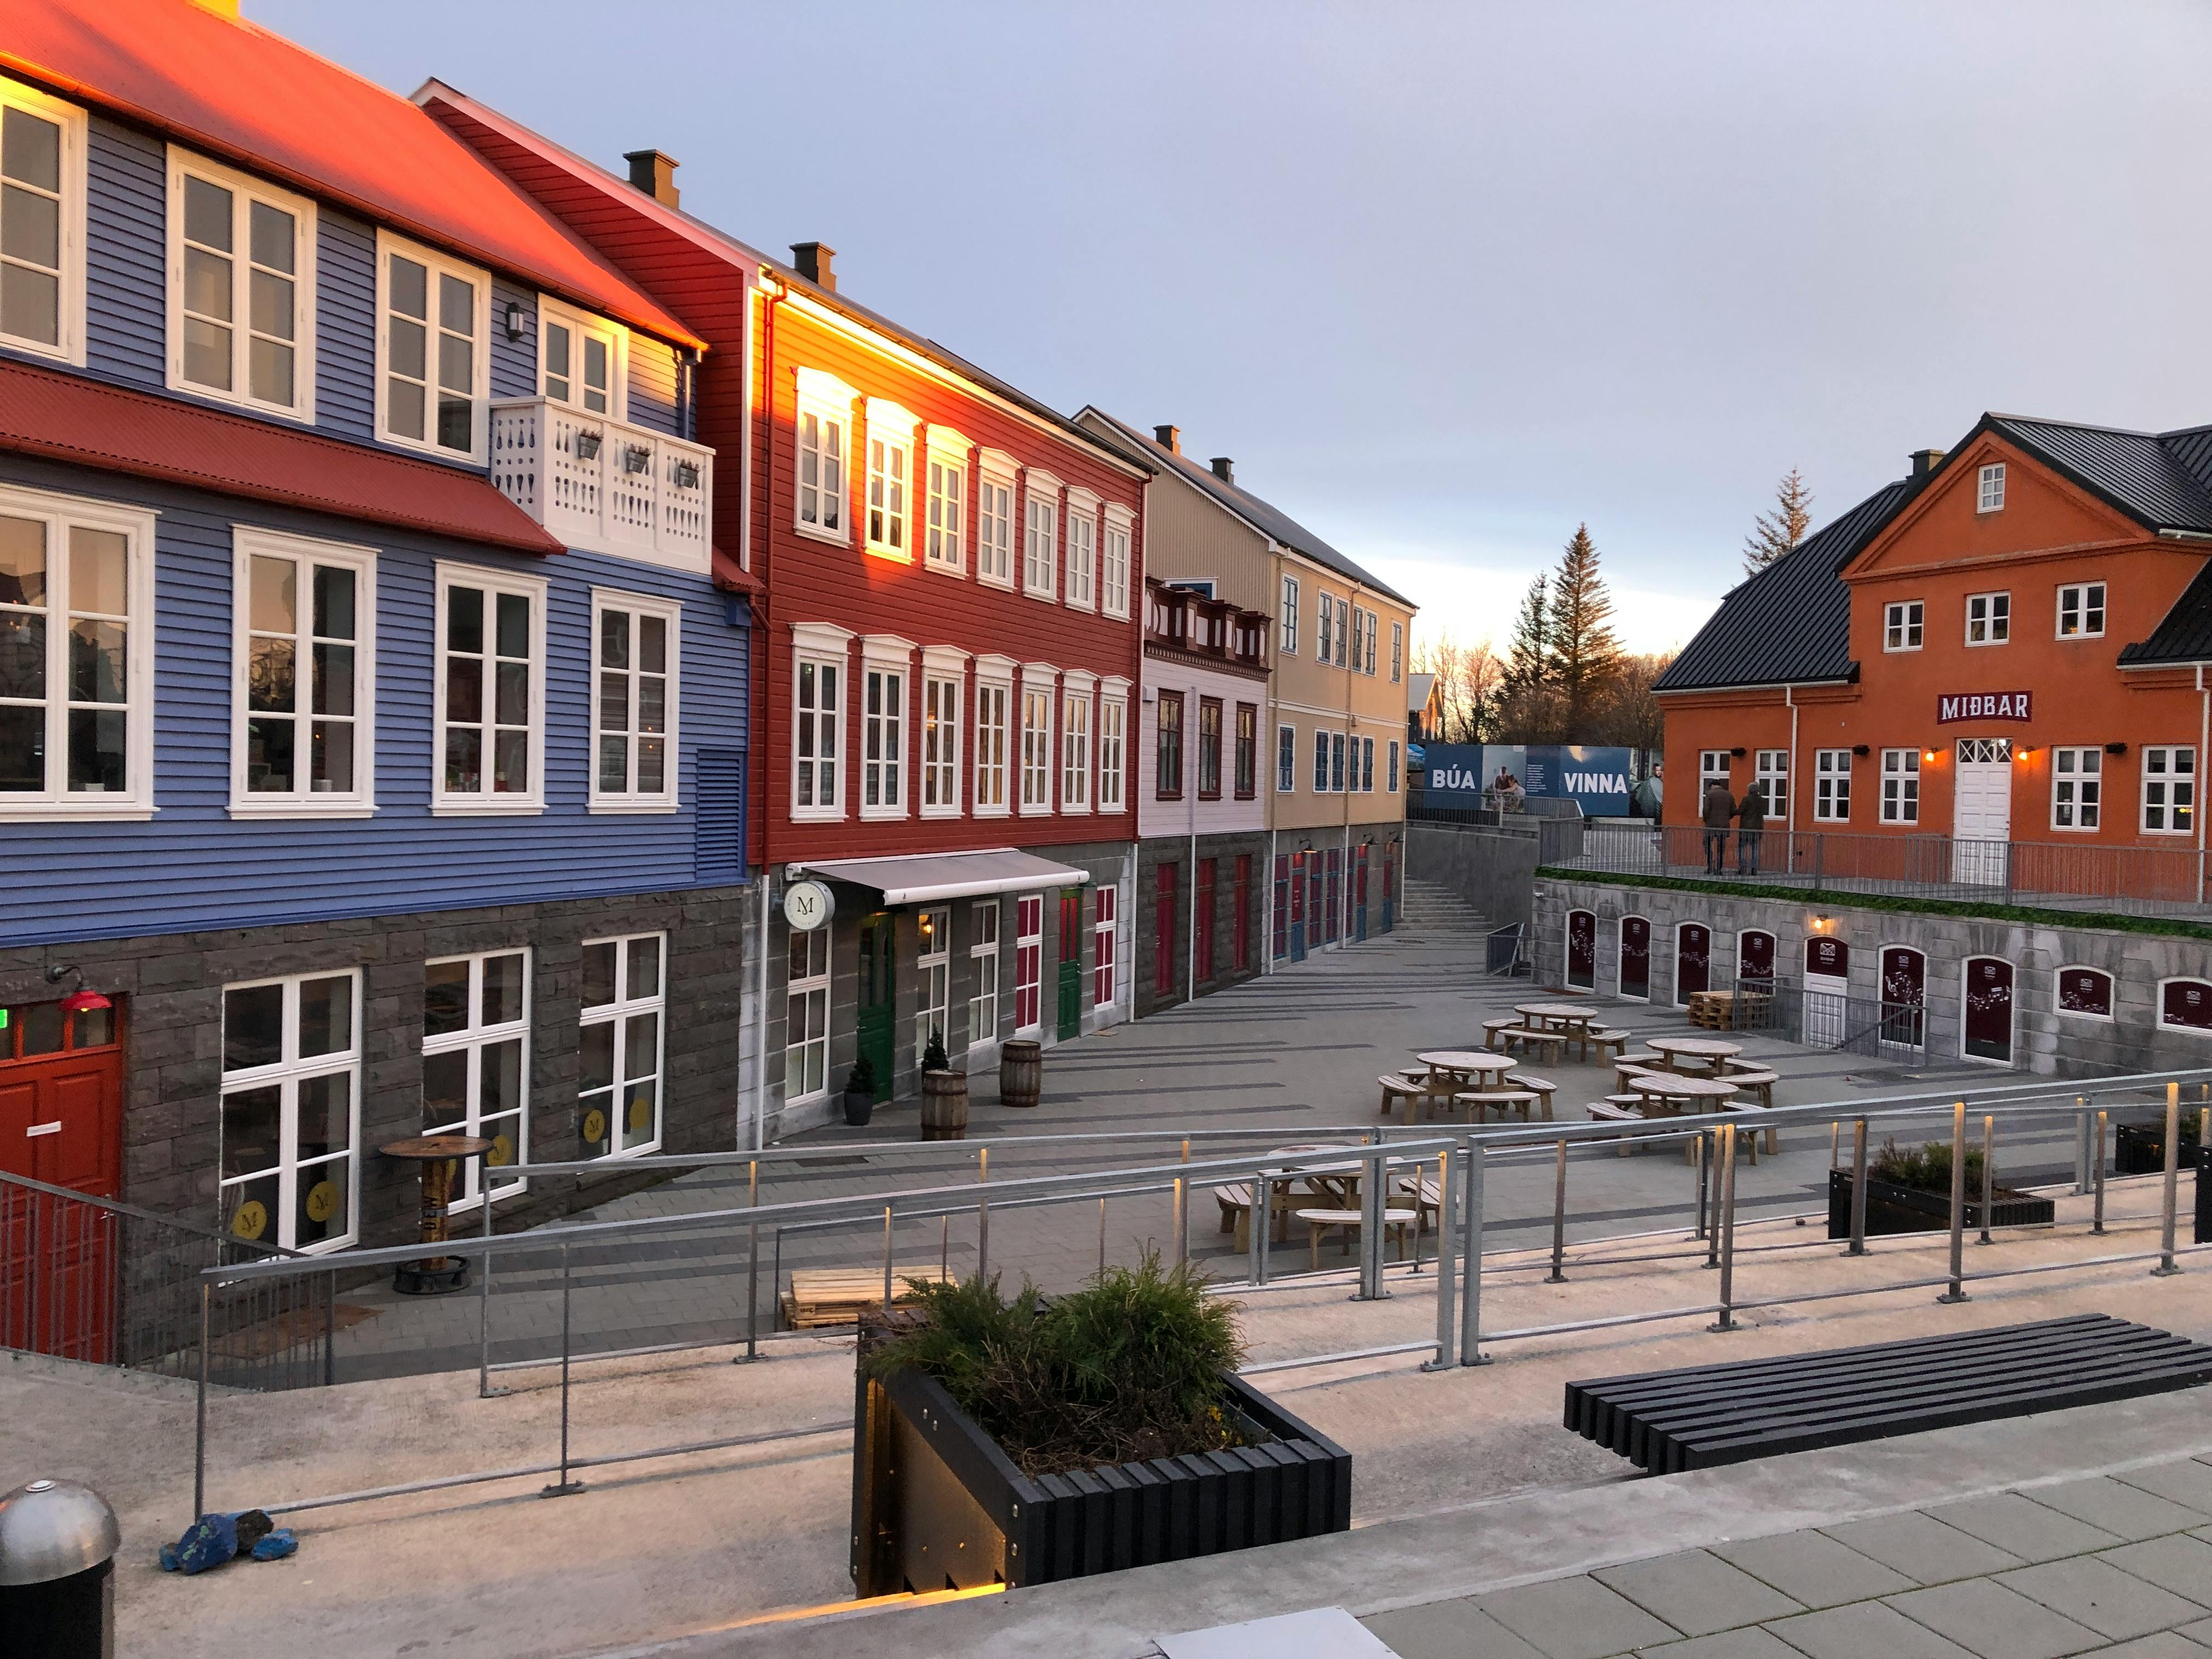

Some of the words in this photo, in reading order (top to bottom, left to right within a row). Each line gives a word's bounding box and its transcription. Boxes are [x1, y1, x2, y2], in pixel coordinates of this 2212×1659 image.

[1942, 695, 2028, 720] MIÐBAR
[1432, 764, 1476, 789] BÚA
[1564, 772, 1628, 794] VINNA
